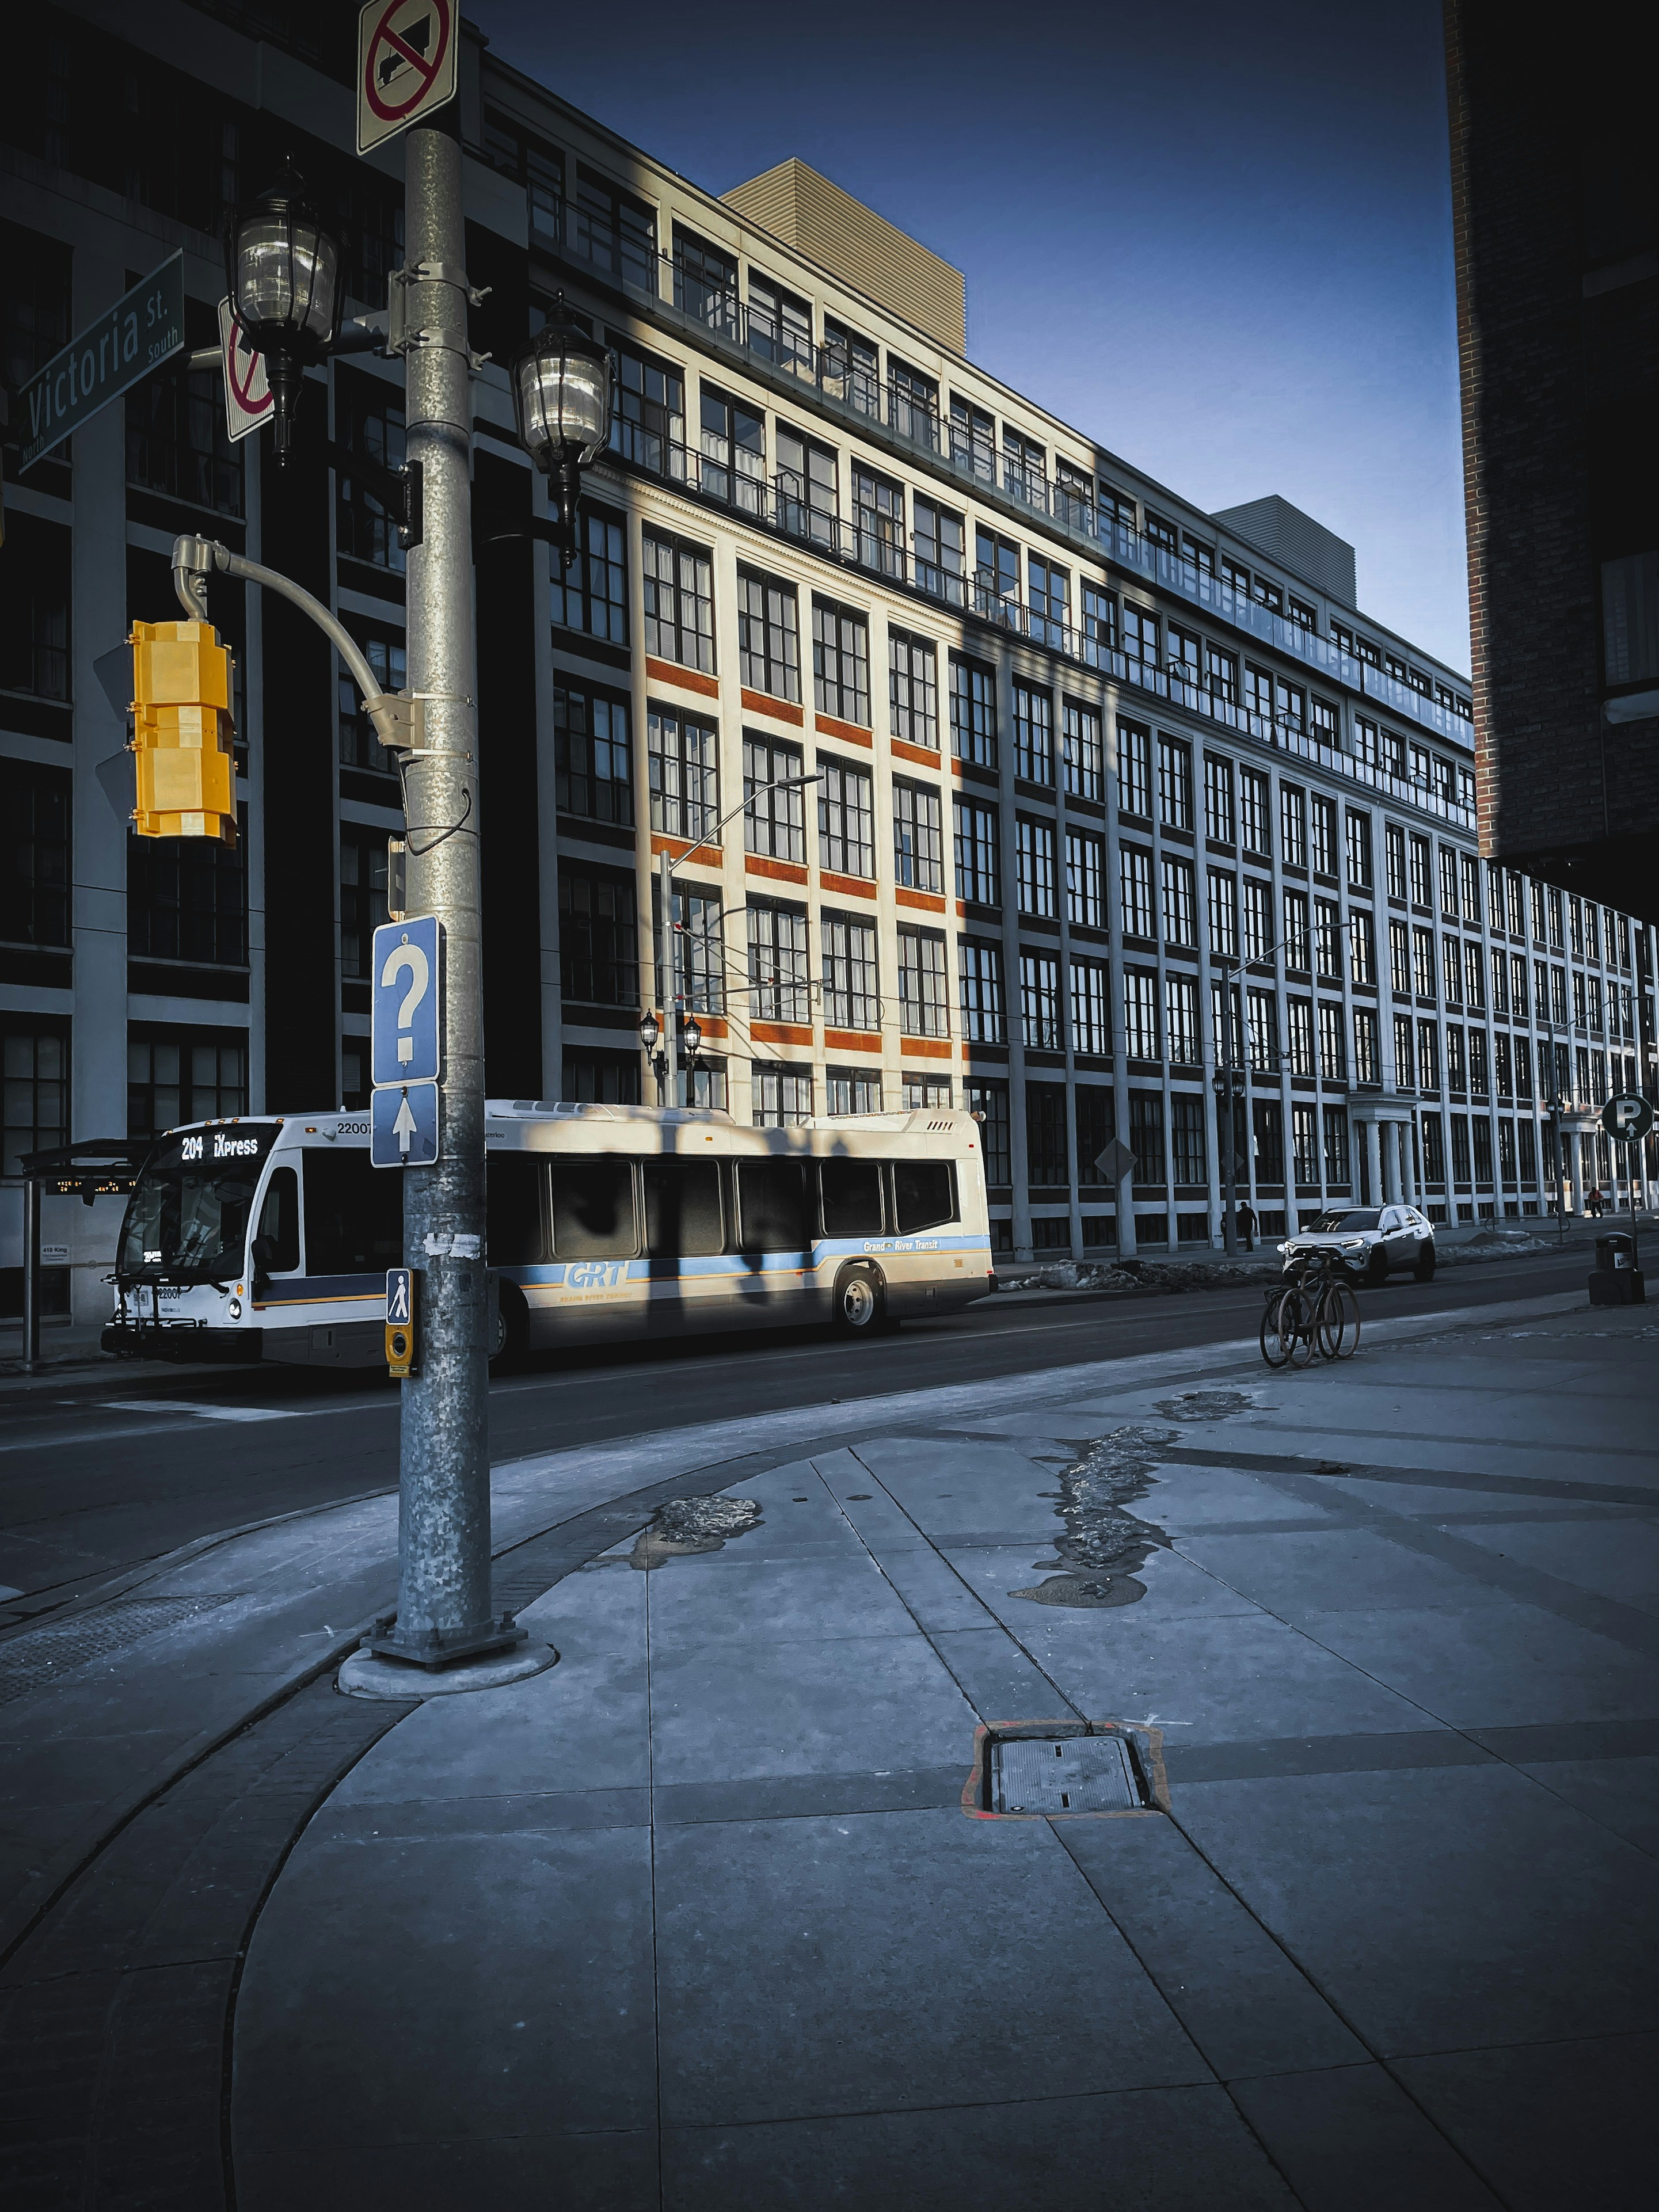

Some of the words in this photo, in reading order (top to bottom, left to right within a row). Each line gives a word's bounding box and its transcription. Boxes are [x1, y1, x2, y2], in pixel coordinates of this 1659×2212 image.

[148, 326, 177, 363] South
[29, 311, 138, 439] Victoria
[147, 290, 167, 327] St.
[23, 434, 44, 465] North
[1616, 1100, 1641, 1128] P
[337, 1123, 371, 1134] 22007
[181, 1136, 203, 1160] 204
[214, 1134, 258, 1158] iXpress
[864, 1241, 885, 1251] Grand
[895, 1240, 914, 1250] River
[915, 1239, 938, 1250] Transit
[568, 1261, 625, 1288] GRT
